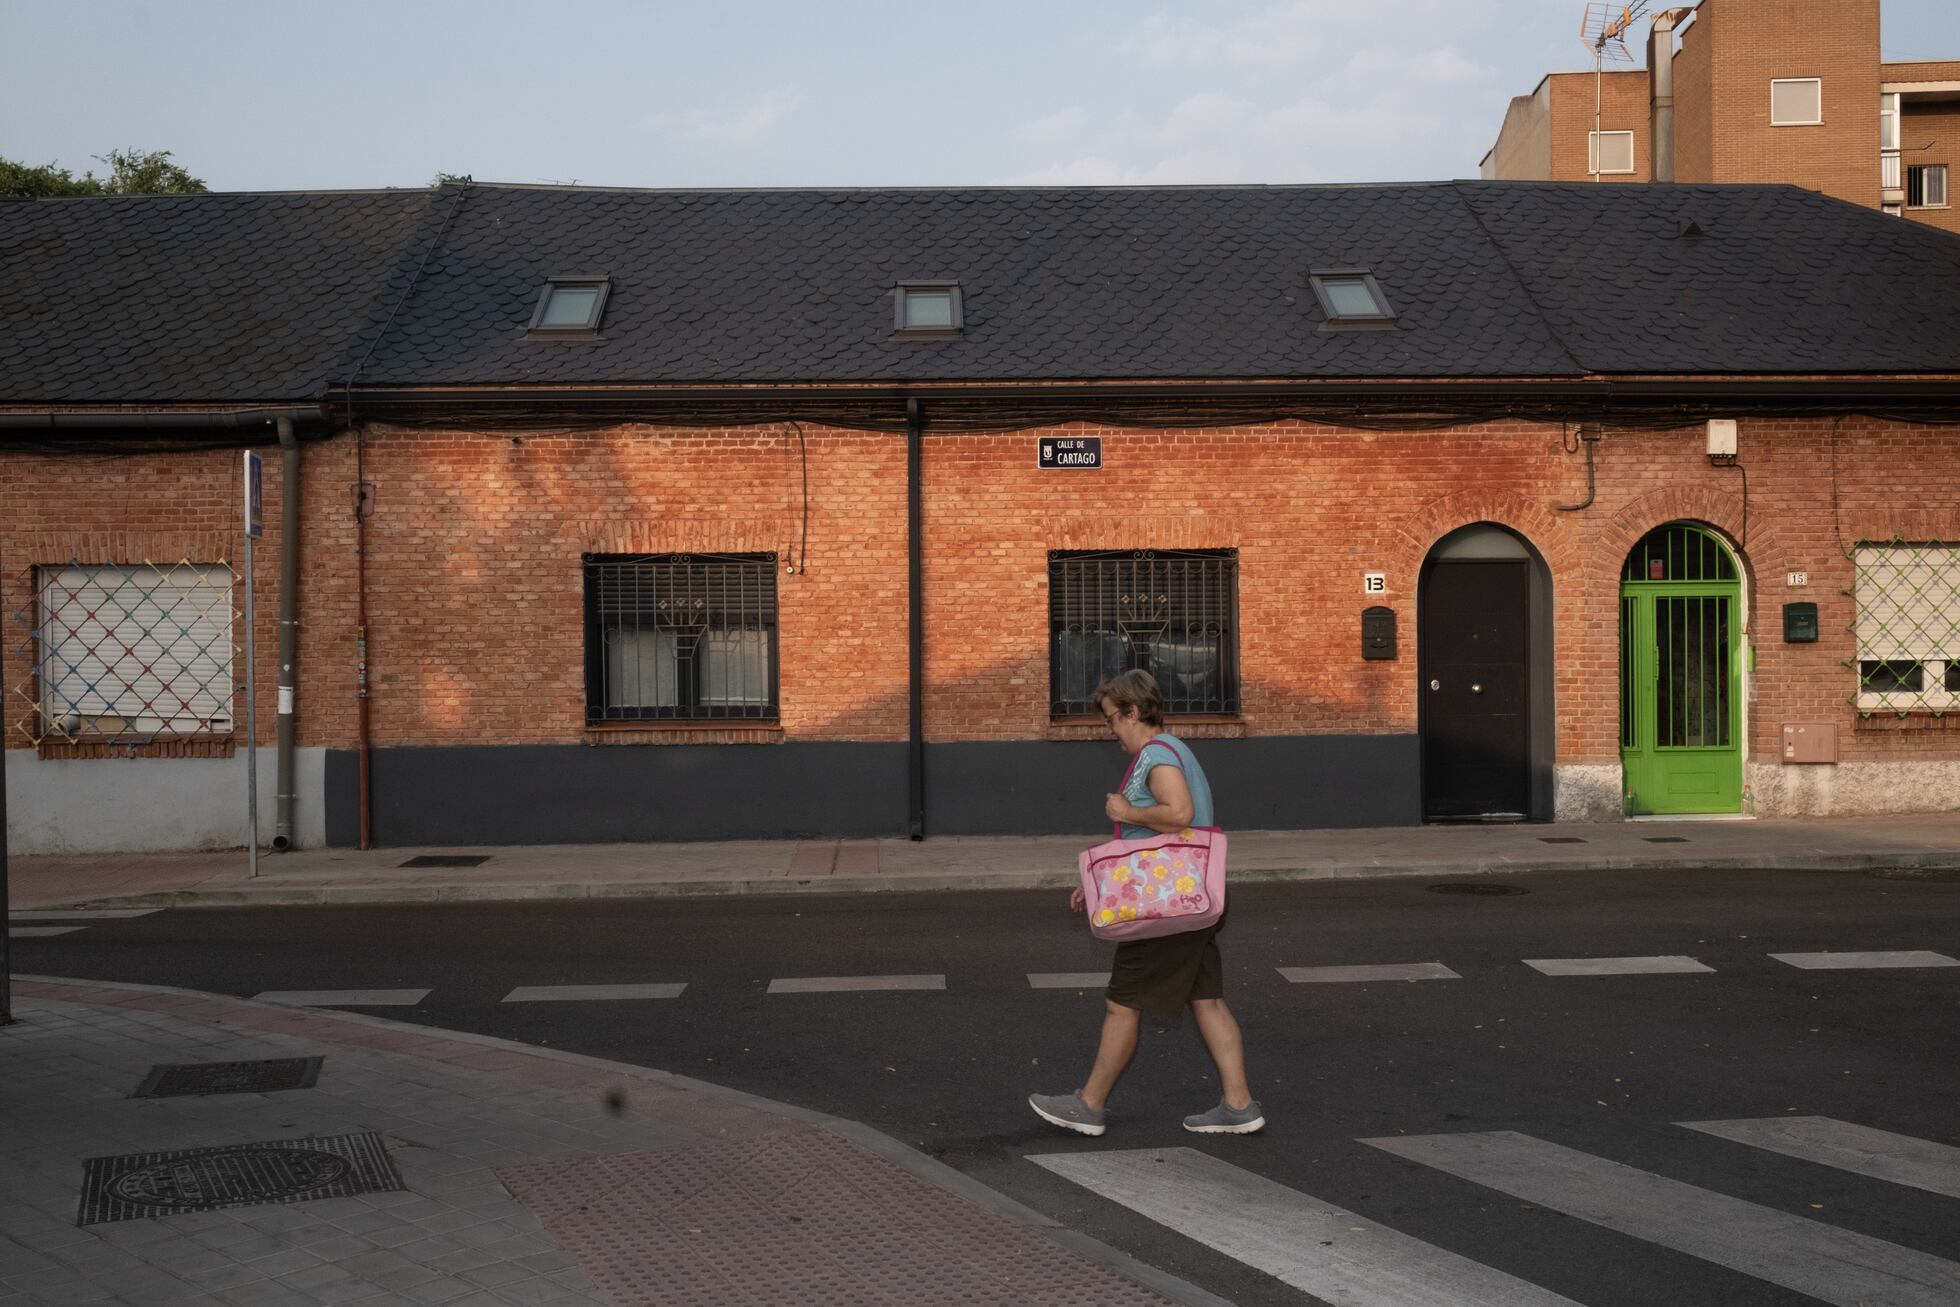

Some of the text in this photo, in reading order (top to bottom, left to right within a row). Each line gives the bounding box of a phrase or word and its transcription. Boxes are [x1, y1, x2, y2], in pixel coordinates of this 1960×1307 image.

[1057, 440, 1084, 448] CALLE DE
[1057, 452, 1096, 464] CARTAGO
[1366, 577, 1384, 590] 13
[1792, 574, 1803, 583] 15
